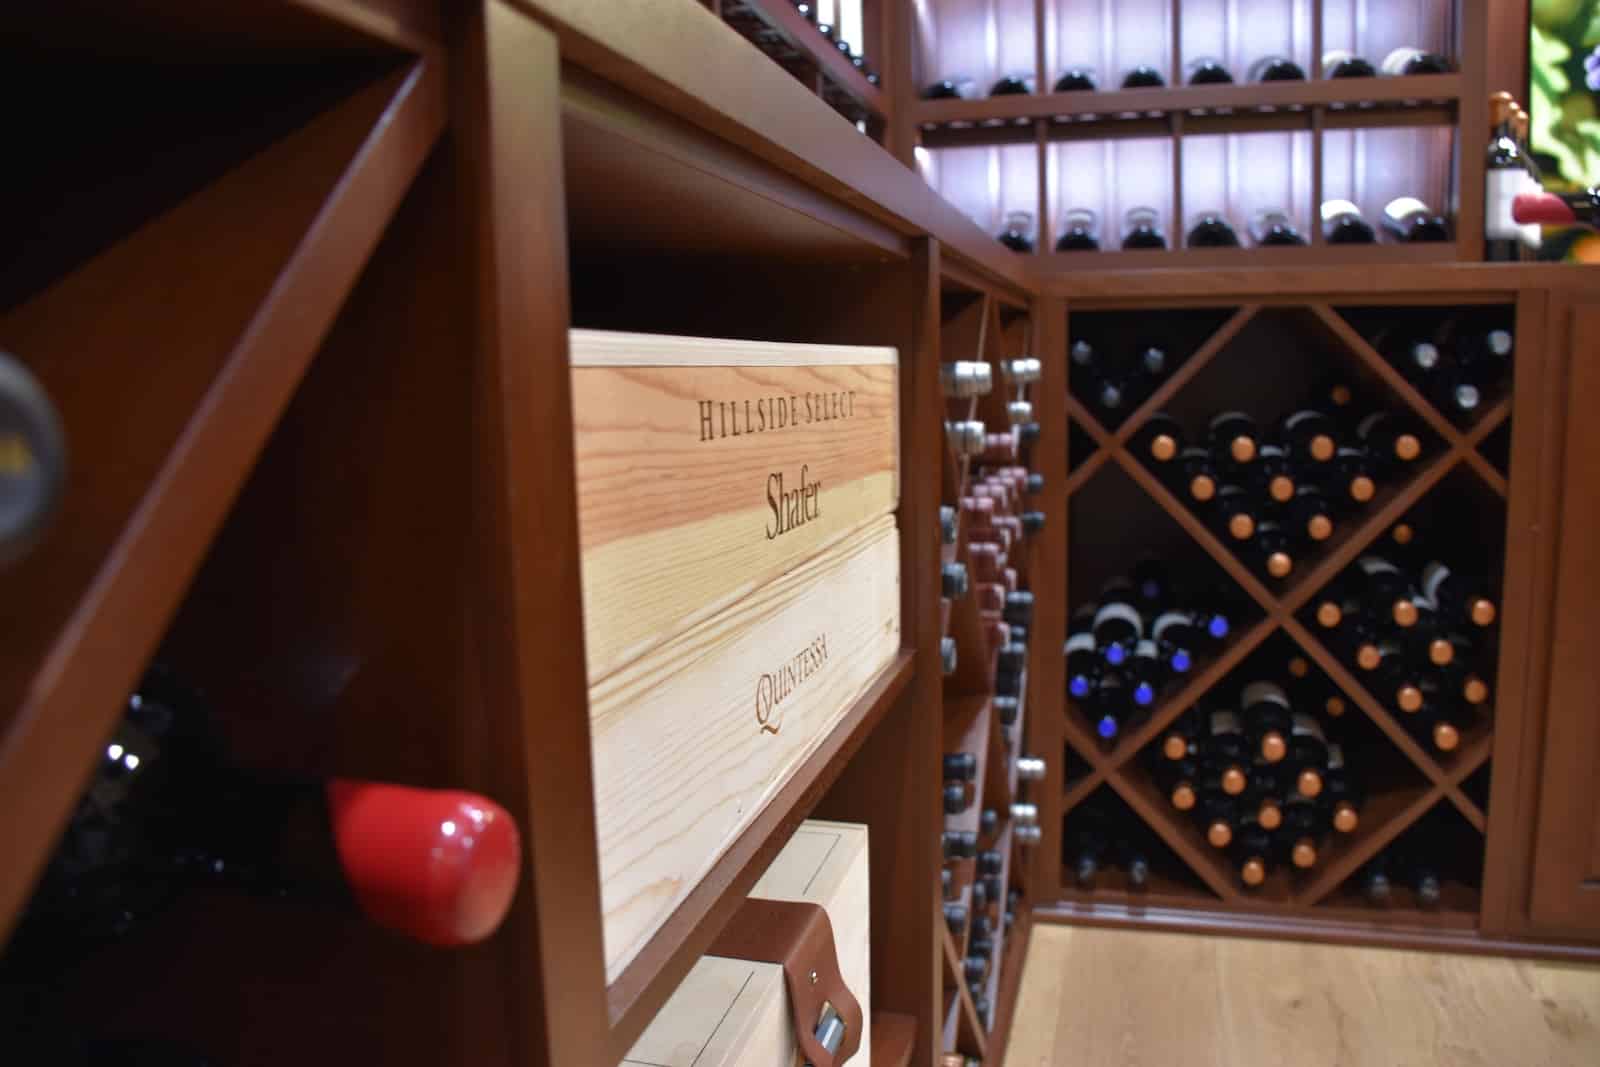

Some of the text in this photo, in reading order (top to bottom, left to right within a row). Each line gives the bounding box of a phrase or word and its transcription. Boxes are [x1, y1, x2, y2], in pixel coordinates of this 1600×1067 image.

[699, 391, 856, 441] HILLSIDE SELECT
[765, 464, 822, 540] Shafer
[756, 634, 828, 734] QUINTESSA
